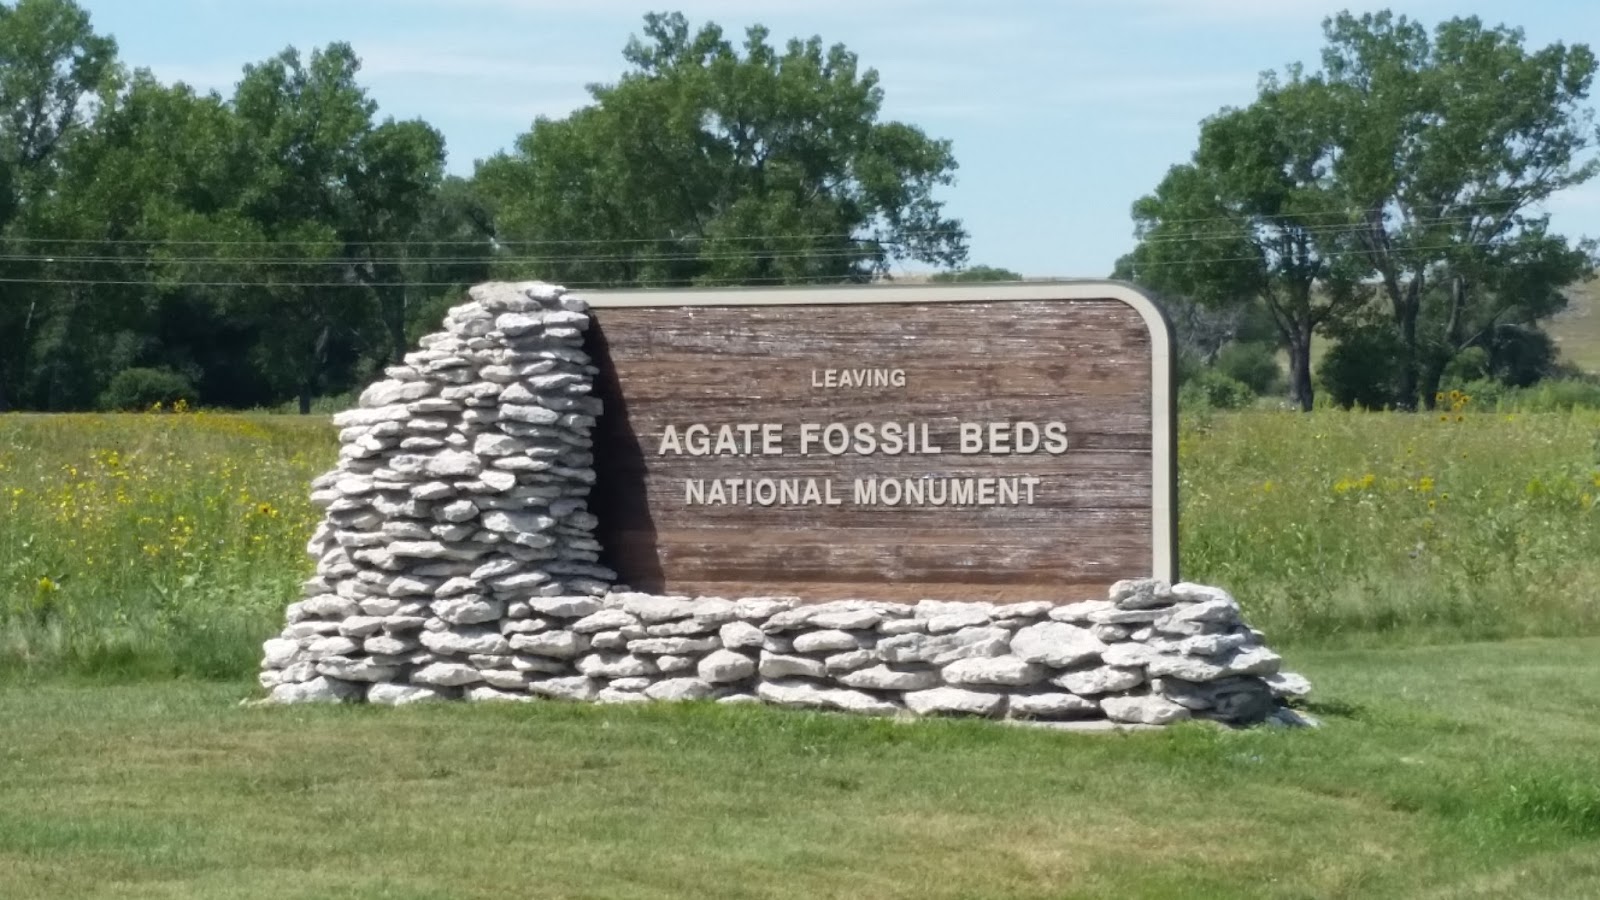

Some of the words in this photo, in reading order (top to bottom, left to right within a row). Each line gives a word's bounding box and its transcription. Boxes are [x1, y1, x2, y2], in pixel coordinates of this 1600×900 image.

[811, 368, 906, 388] LEAVING
[658, 423, 784, 456] AGATE
[799, 422, 943, 455] FOSSIL
[959, 421, 1069, 454] BEDS
[684, 478, 843, 506] NATIONAL
[853, 476, 1041, 505] MONUMENT
